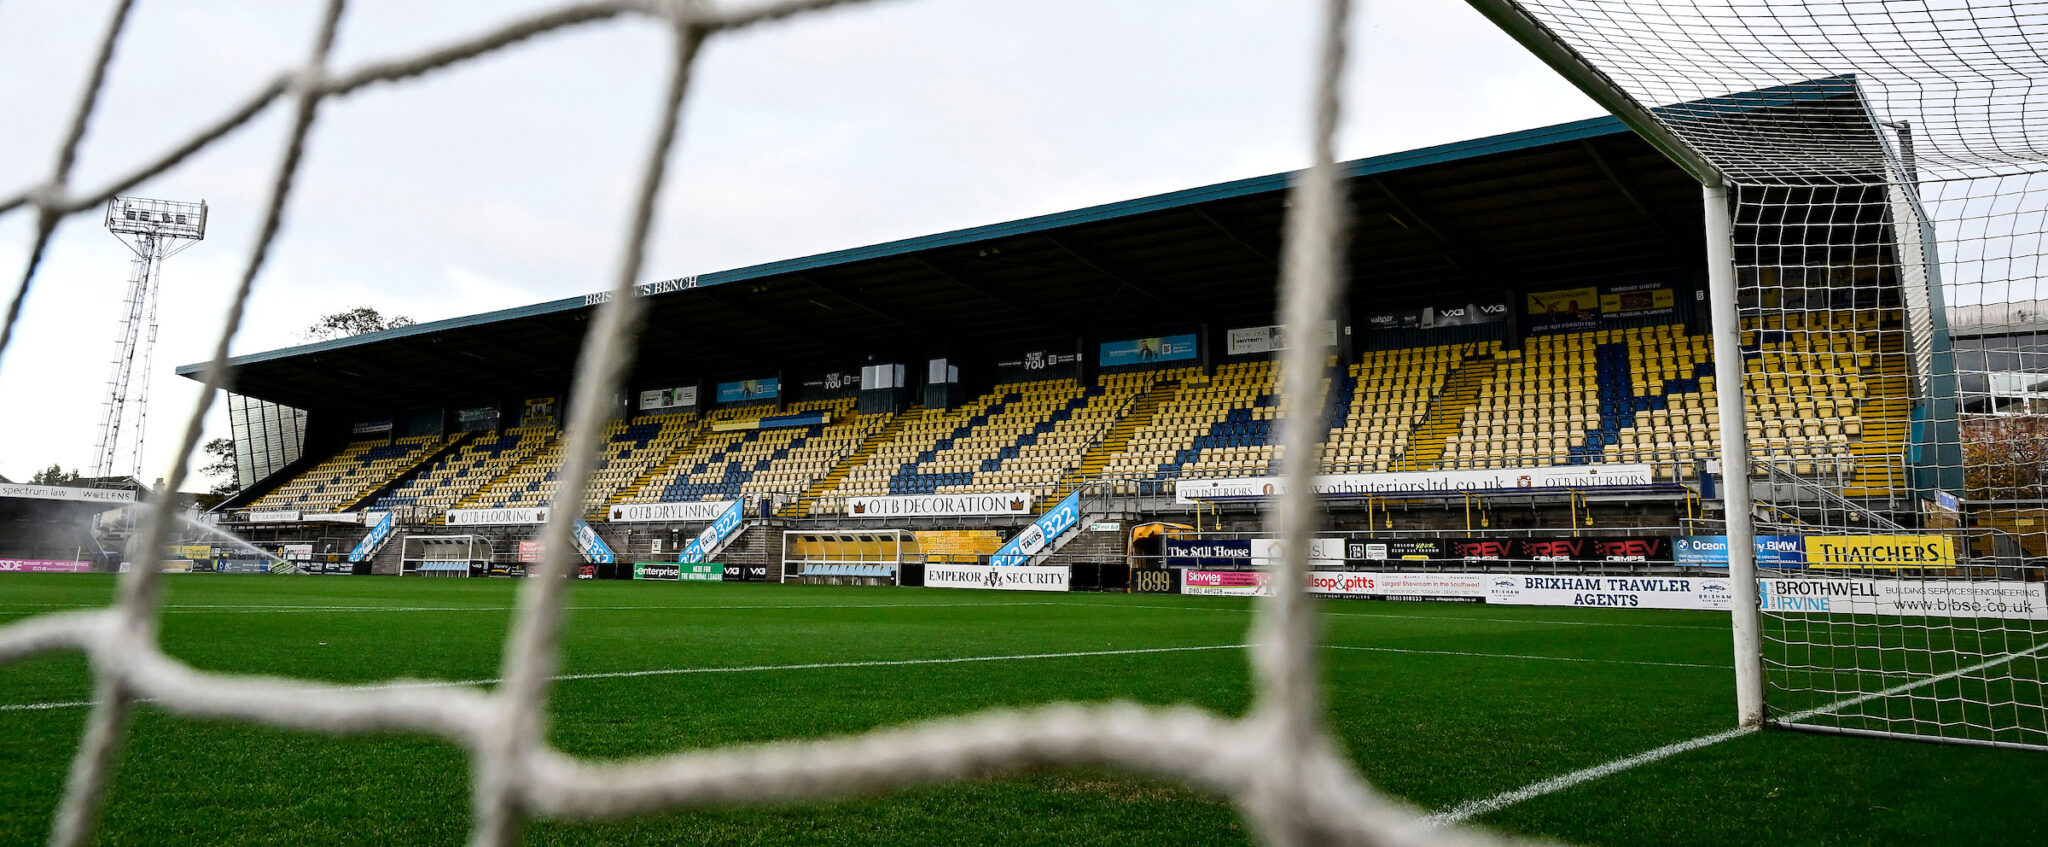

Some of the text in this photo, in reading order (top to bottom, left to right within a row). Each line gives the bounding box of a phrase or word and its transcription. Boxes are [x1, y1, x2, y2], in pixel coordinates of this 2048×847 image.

[584, 275, 698, 306] BRISW'S BENCH
[1440, 309, 1465, 317] VX3
[1480, 304, 1505, 313] VX3
[1024, 359, 1045, 370] YOU
[824, 379, 842, 389] YOU
[1545, 474, 1647, 487] OTB INTERIORS
[2, 486, 67, 498] spectrum law
[1201, 487, 1253, 498] INTERIORS
[629, 504, 720, 520] OTB DRYLINING
[869, 496, 1007, 514] OTB DECORATION
[461, 510, 531, 523] OTB FLOORING
[1043, 507, 1075, 539] 322
[716, 511, 741, 538] 322
[373, 523, 389, 541] 322
[1021, 531, 1042, 549] TAXIS
[1692, 540, 1726, 550] Ocean
[1766, 541, 1797, 551] BMW
[1168, 546, 1249, 558] The Still House
[1464, 540, 1512, 557] REV
[1531, 540, 1583, 557] REV
[1602, 539, 1660, 557] REV
[1819, 543, 1940, 562] THATCHERS
[637, 566, 679, 578] enterprise
[692, 565, 704, 573] HERE
[723, 566, 766, 576] VX3 VX3
[707, 573, 723, 581] LEAGUE
[929, 570, 1065, 585] EMPEROR SECURITY
[1136, 570, 1170, 592] 1899
[1188, 572, 1222, 582] Skivvies
[1306, 573, 1375, 592] llsop&pitts
[1524, 577, 1601, 591] BRIXHAM
[1607, 579, 1691, 592] TRAWLER
[1776, 581, 1880, 597] BROTHWELL
[1885, 586, 2040, 598] BULDING SERVICES ENGINEERING
[1573, 593, 1639, 607] AGENTS
[1777, 595, 1830, 611] IRVINE
[1893, 597, 2034, 614] www.bbse.co.uk
